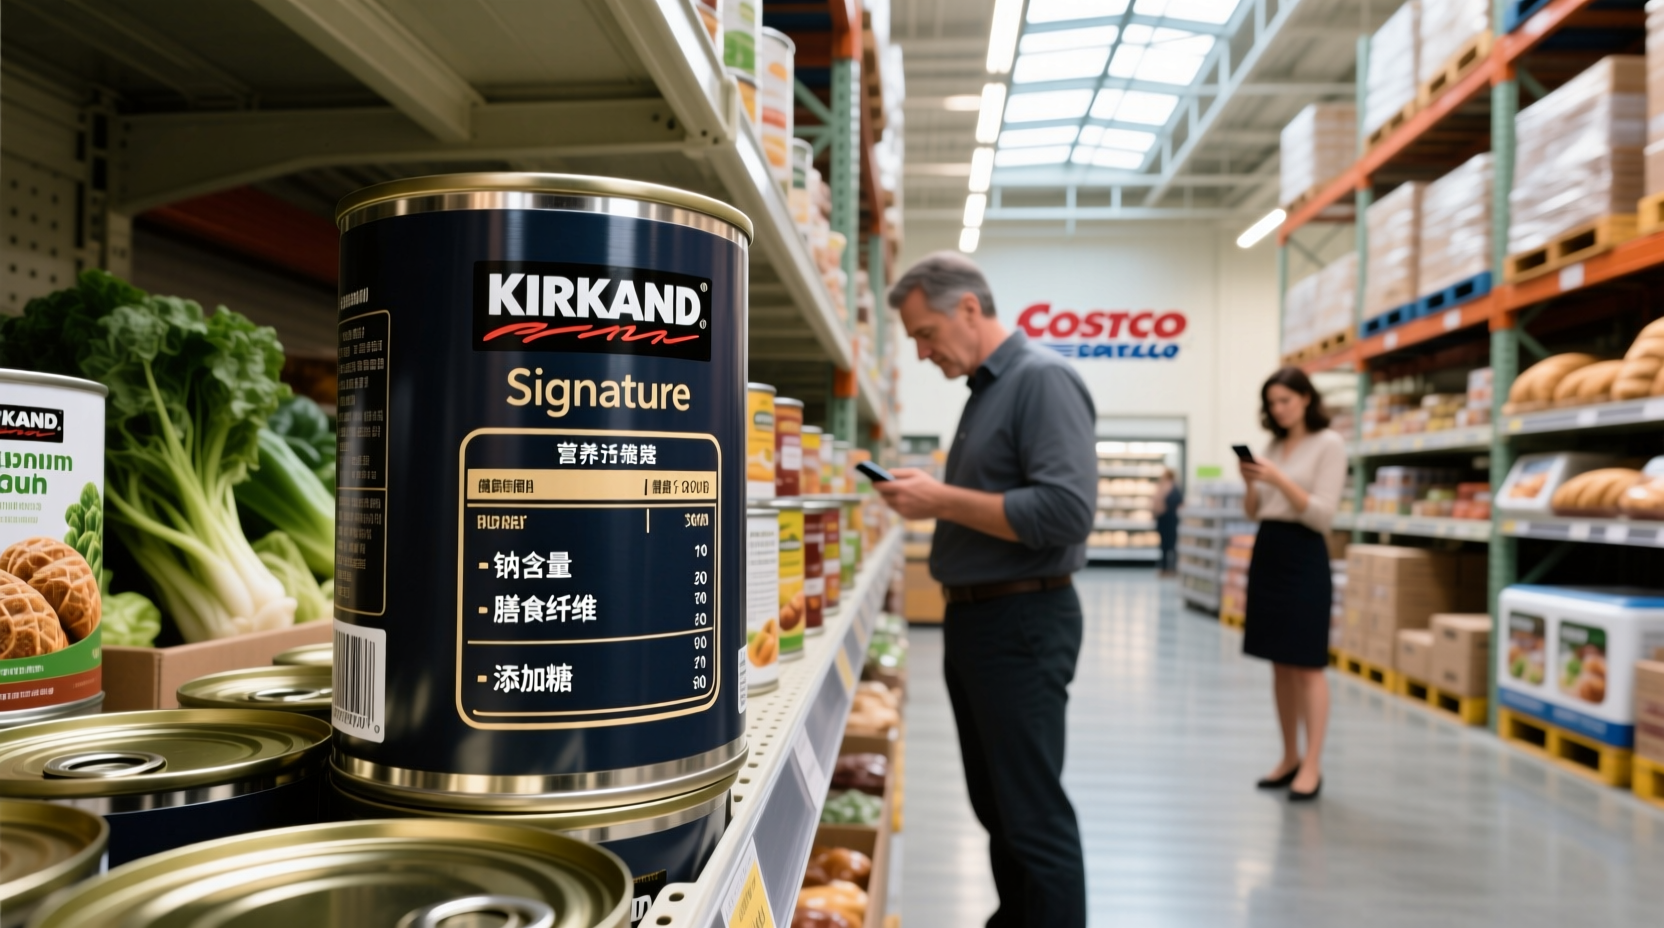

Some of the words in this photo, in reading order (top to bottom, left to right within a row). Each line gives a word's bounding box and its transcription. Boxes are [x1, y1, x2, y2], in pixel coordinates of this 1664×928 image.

[488, 273, 701, 326] KIRKAND
[1016, 302, 1187, 338] COSTCO
[506, 367, 690, 417] Signature
[494, 551, 572, 579] 钠含量
[494, 595, 597, 623] 膳食纤维
[494, 663, 573, 693] 添加糖
